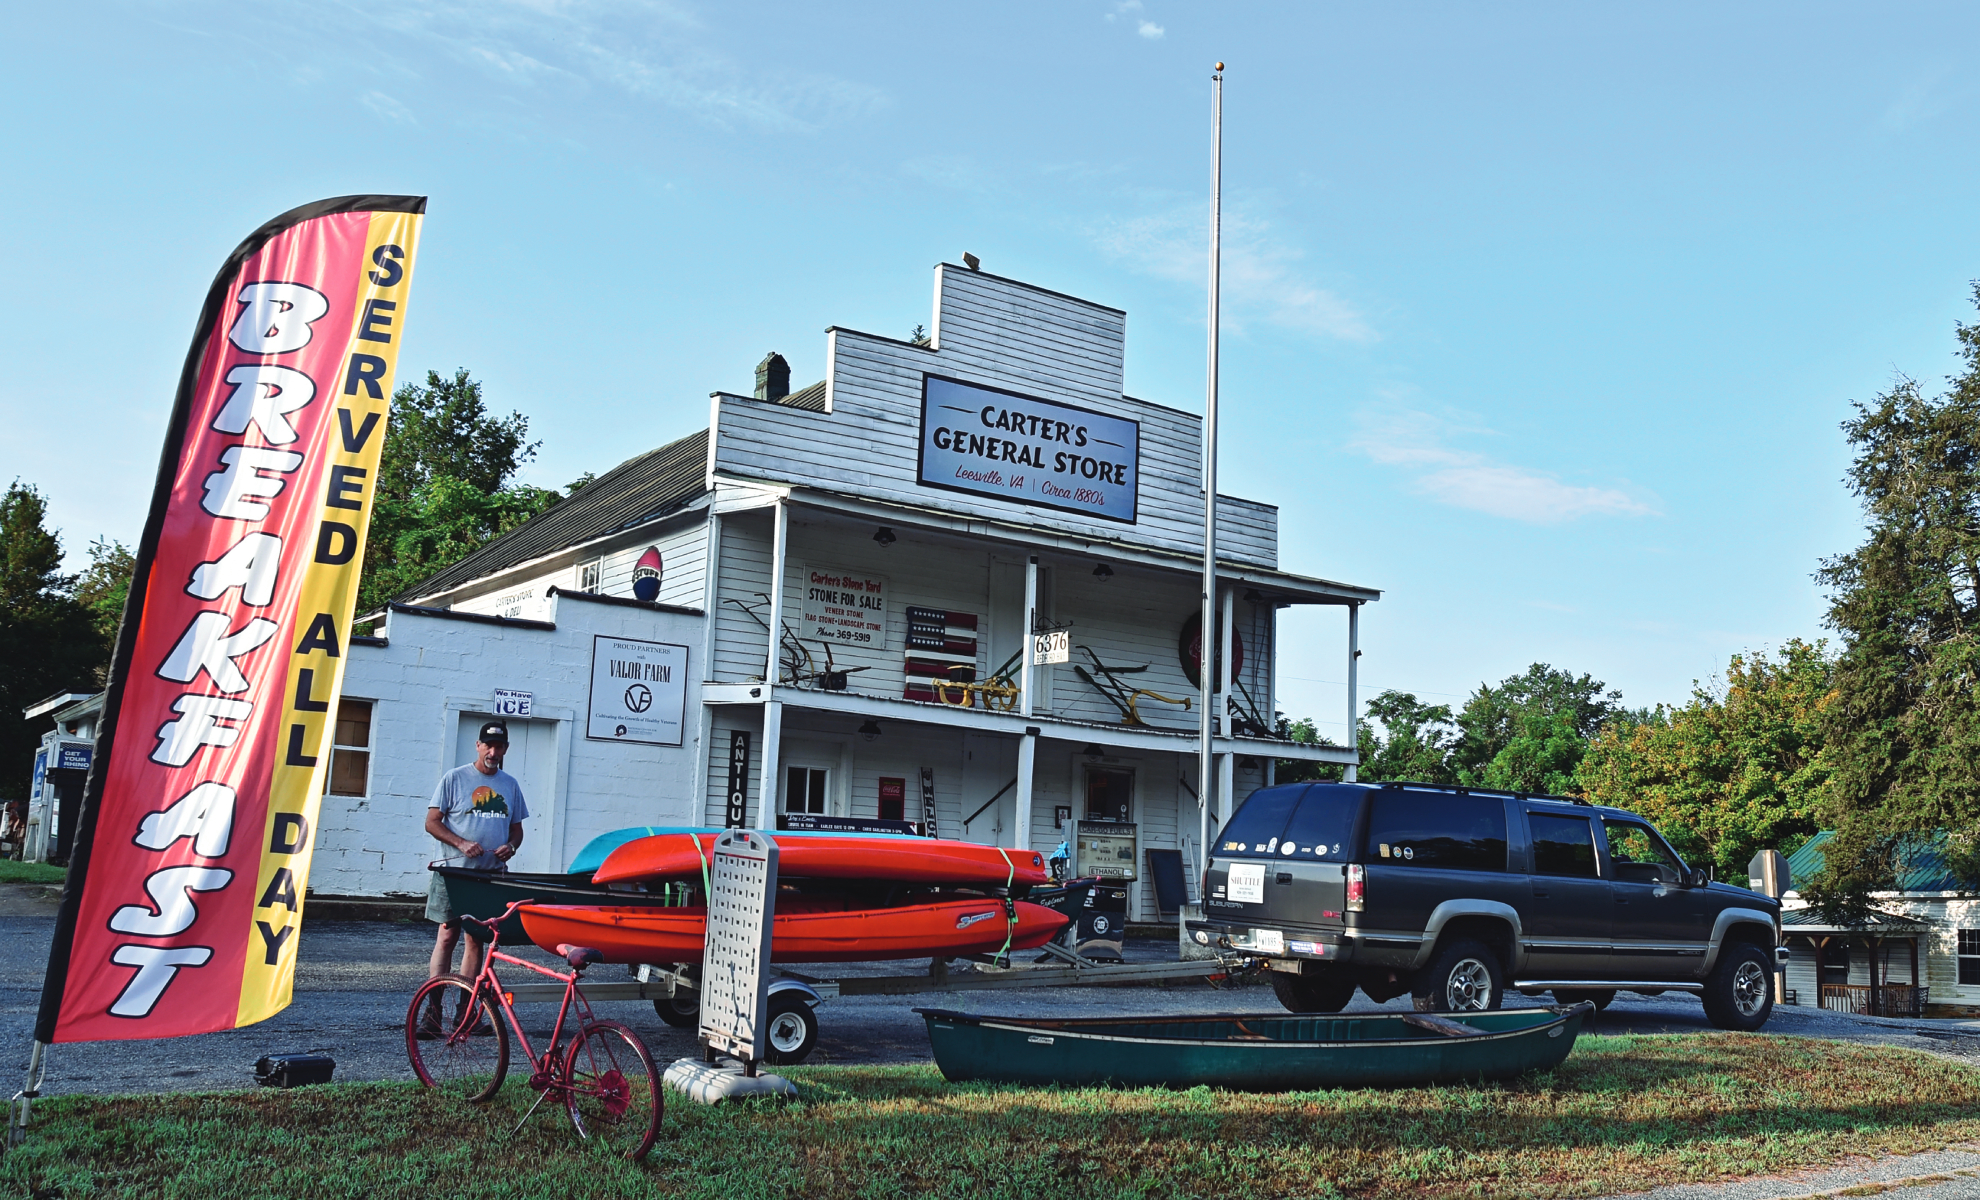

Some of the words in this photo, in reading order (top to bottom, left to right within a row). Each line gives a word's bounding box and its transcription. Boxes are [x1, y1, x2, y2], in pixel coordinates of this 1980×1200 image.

[314, 244, 404, 566] SERVED
[981, 406, 1088, 447] CARTER'S
[933, 427, 1046, 469] GENERAL
[1053, 451, 1128, 486] STORE
[1009, 474, 1024, 490] VA
[1041, 480, 1072, 500] Circa
[1073, 487, 1105, 506] 1880's
[811, 572, 841, 588] Carter's
[841, 577, 864, 591] Stone
[865, 579, 882, 593] Yard
[809, 588, 838, 604] STONE
[840, 593, 855, 607] FOR
[859, 596, 882, 611] SALE
[805, 613, 816, 622] FLAG
[866, 622, 882, 632] STONE
[824, 606, 845, 616] VENEER
[846, 610, 864, 619] STONE
[836, 629, 871, 642] 369-5919
[1036, 634, 1067, 653] 6376
[106, 281, 329, 1019] BREAKFAST
[613, 642, 637, 651] PROUD
[637, 645, 671, 655] PARTNERS
[610, 659, 641, 680] VALOR
[644, 663, 671, 683] FARM
[286, 613, 340, 767] ALL
[495, 689, 508, 697] We
[510, 691, 532, 699] Have
[496, 698, 530, 715] ICE
[731, 735, 745, 829] ANTIQU
[472, 809, 506, 819] Virginia
[1091, 868, 1122, 876] ETHANOL
[1231, 876, 1261, 886] SHUTTLE
[254, 813, 309, 965] DAY
[1208, 900, 1244, 909] SUBURBAN
